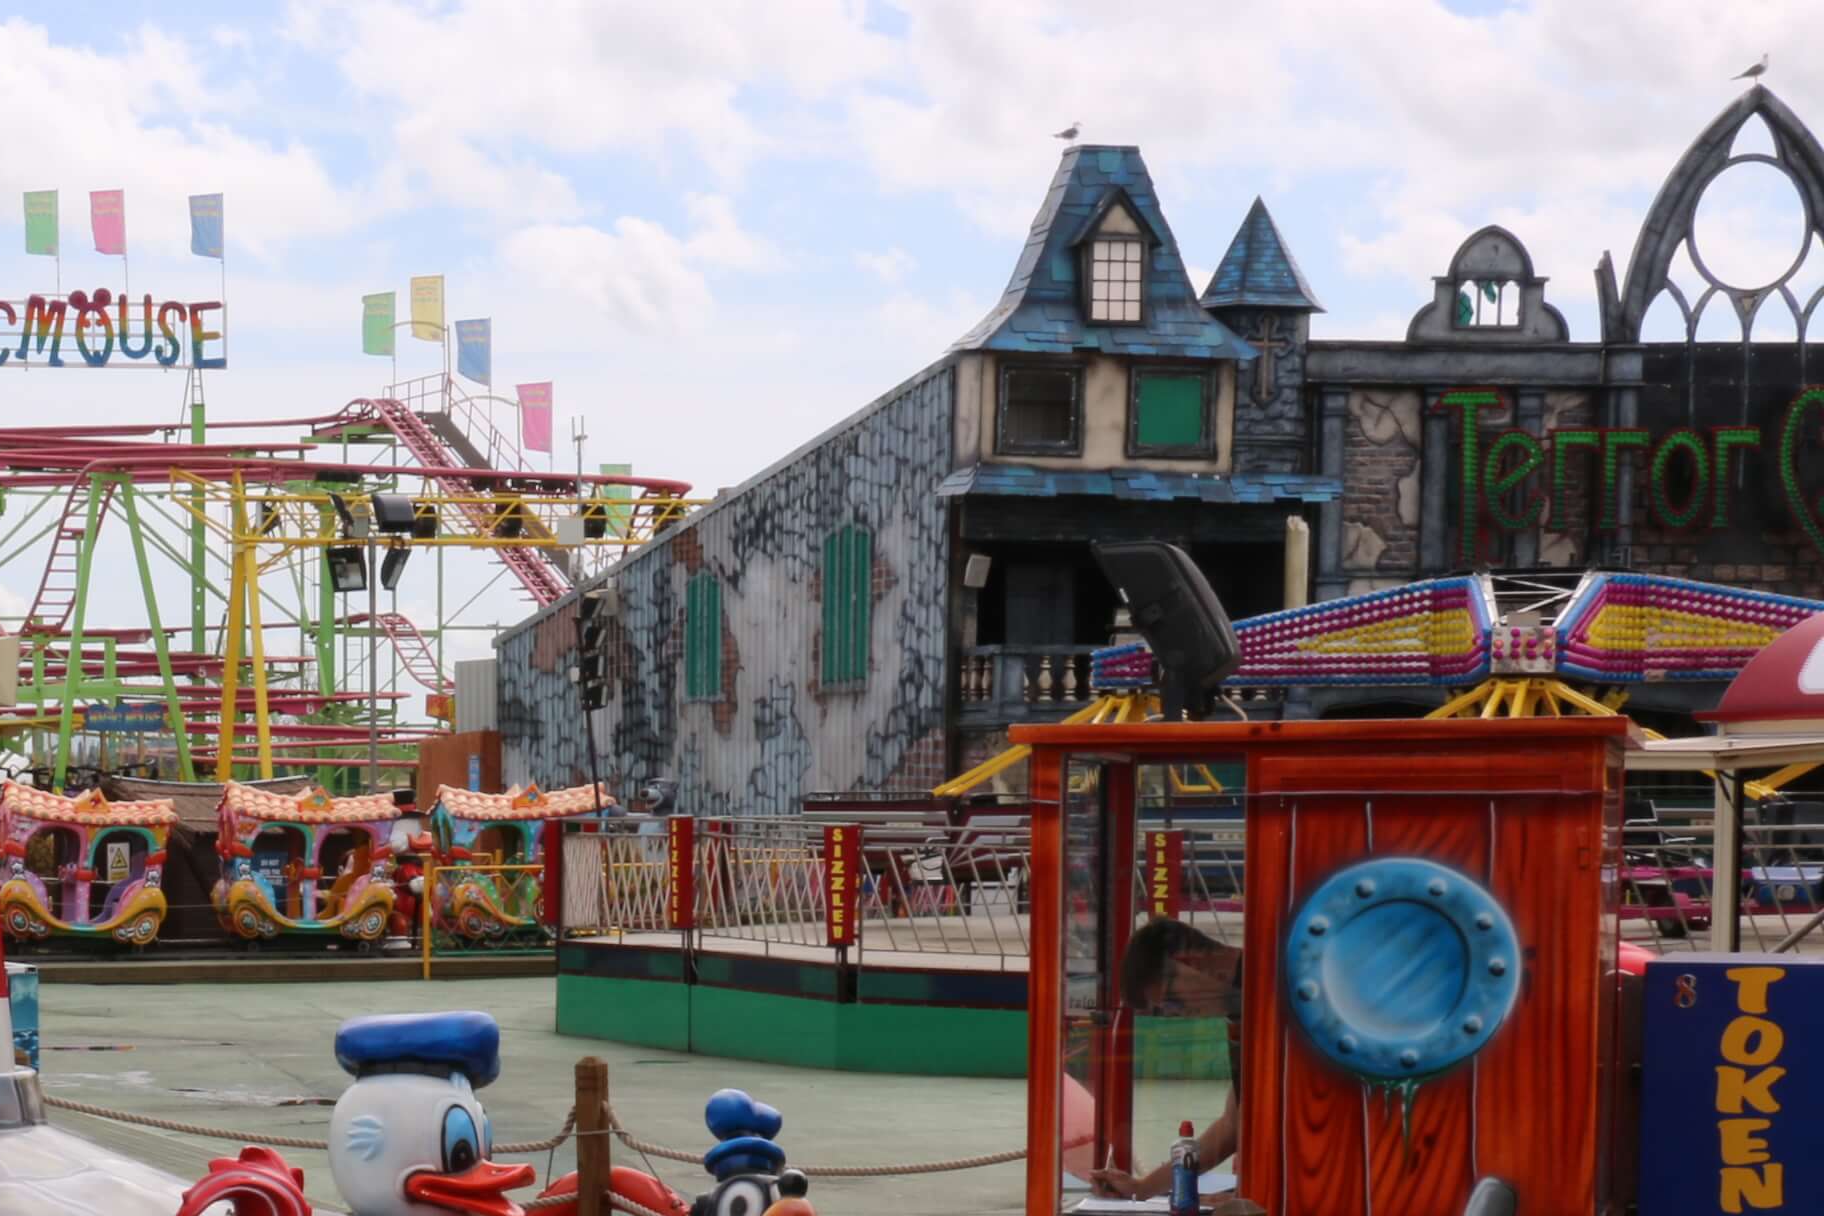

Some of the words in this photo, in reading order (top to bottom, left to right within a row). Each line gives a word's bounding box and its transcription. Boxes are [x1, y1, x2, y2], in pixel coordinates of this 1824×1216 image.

[1440, 390, 1761, 565] Terror
[1674, 973, 1698, 1009] 8
[1714, 966, 1789, 1214] TOKEN
